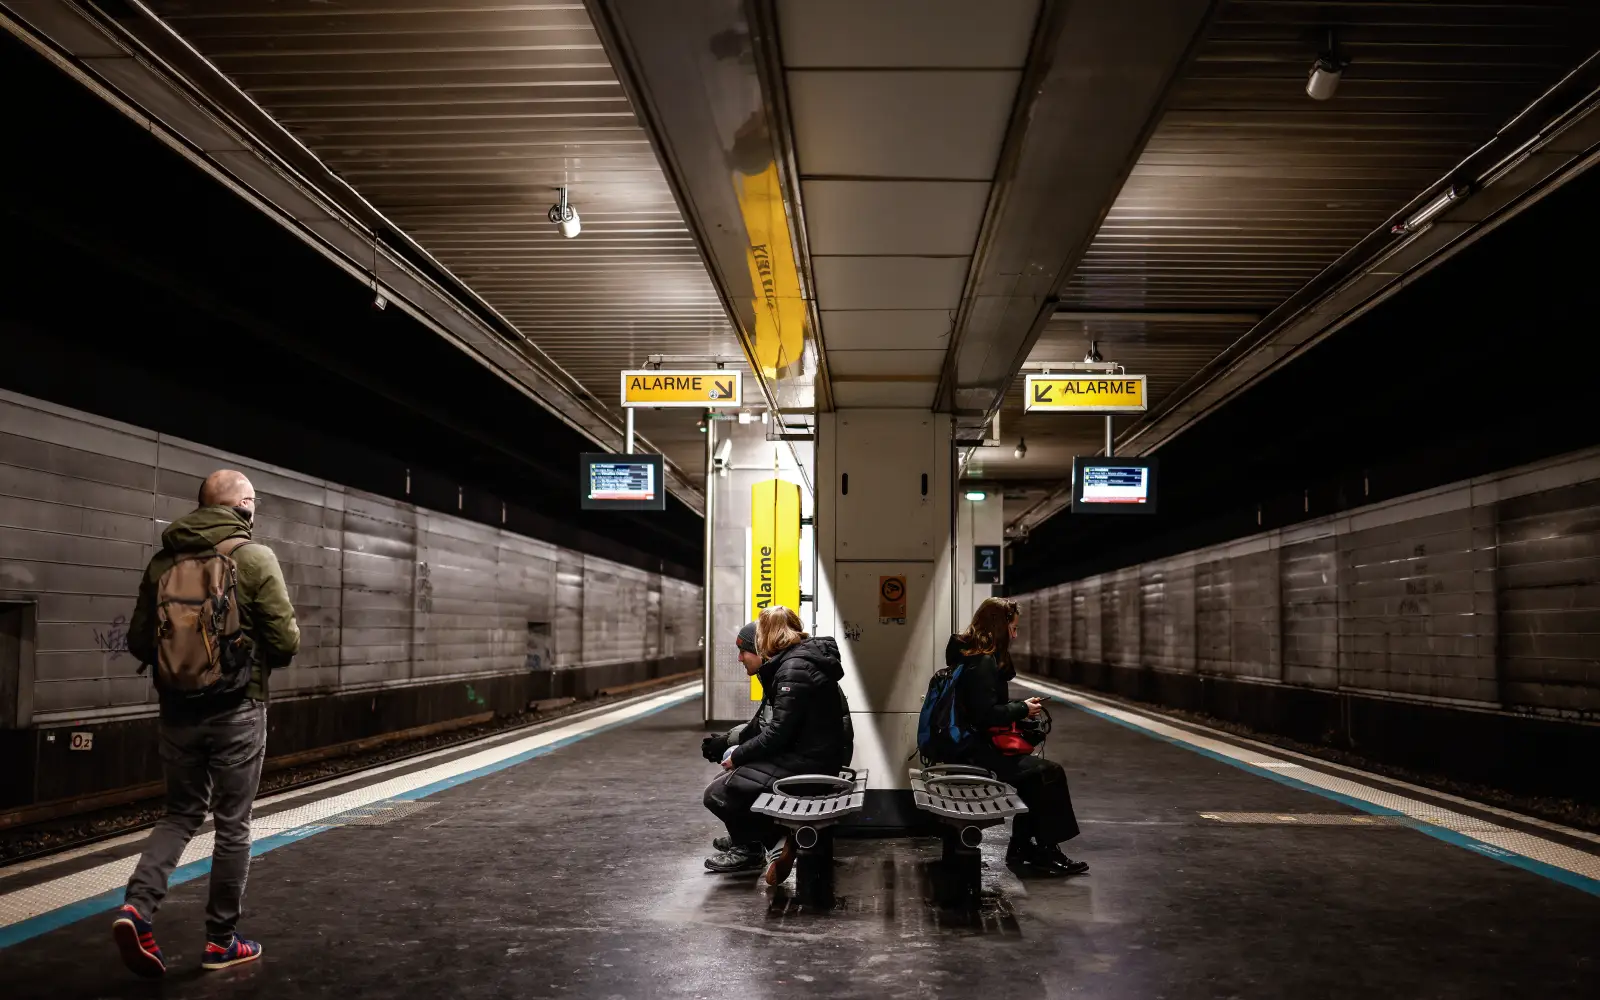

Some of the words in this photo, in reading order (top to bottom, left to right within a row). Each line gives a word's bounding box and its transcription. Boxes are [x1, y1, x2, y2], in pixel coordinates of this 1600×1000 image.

[630, 377, 702, 390] ALARME
[1064, 381, 1136, 394] ALARME
[982, 556, 993, 570] 4
[756, 546, 772, 609] Alarme
